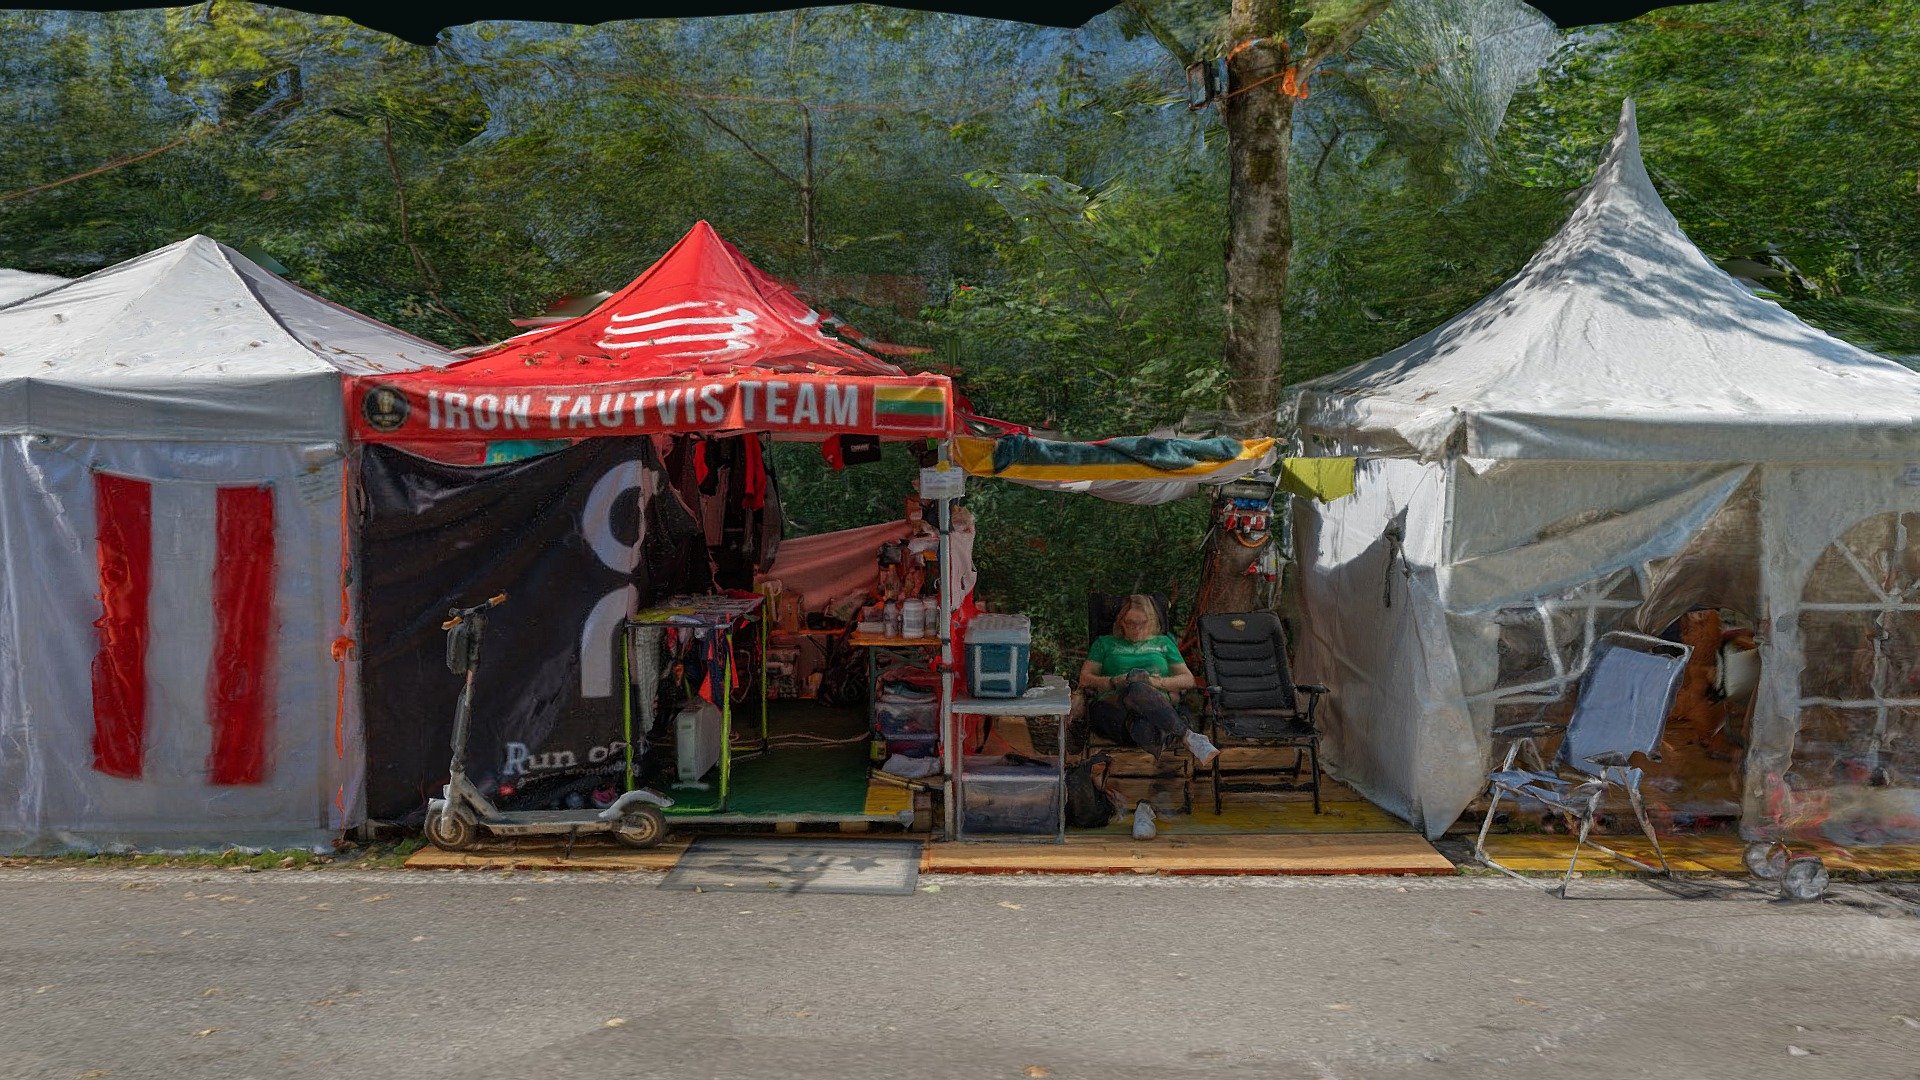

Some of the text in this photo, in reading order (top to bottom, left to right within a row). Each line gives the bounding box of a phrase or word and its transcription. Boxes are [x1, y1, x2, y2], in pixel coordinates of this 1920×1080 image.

[427, 381, 858, 430] IRON TAUTVIS TEAM
[504, 741, 578, 775] Run
